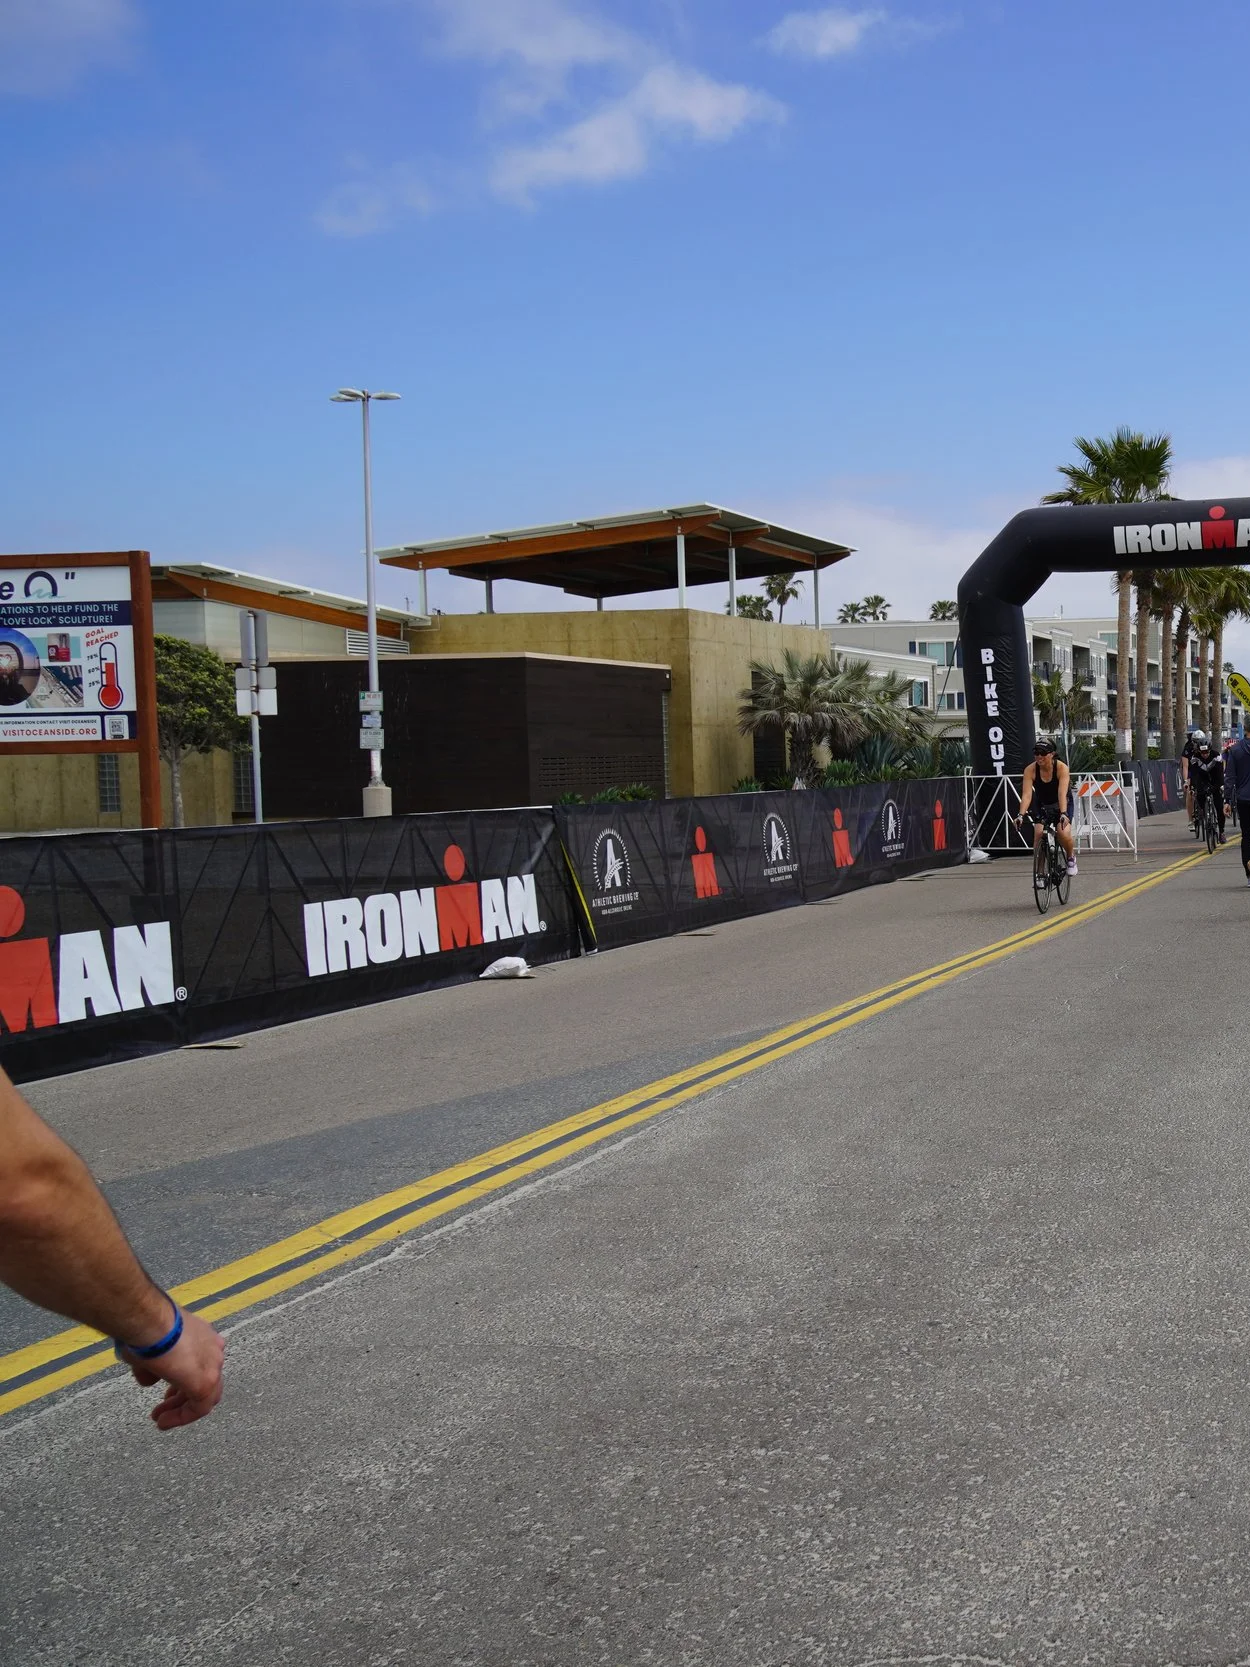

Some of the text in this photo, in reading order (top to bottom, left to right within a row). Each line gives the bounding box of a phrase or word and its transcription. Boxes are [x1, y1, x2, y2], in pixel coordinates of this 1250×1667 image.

[0, 603, 119, 615] ATIONS TO HELP FUND THE
[59, 615, 113, 624] SCULPTURE!
[85, 627, 105, 639] GOAL
[86, 631, 119, 648] REACHED
[980, 648, 1000, 717] BIKE
[2, 728, 98, 737] VISITOCEANSIDE.ORG
[988, 726, 1005, 776] OUT
[303, 850, 540, 977] IRONMAN
